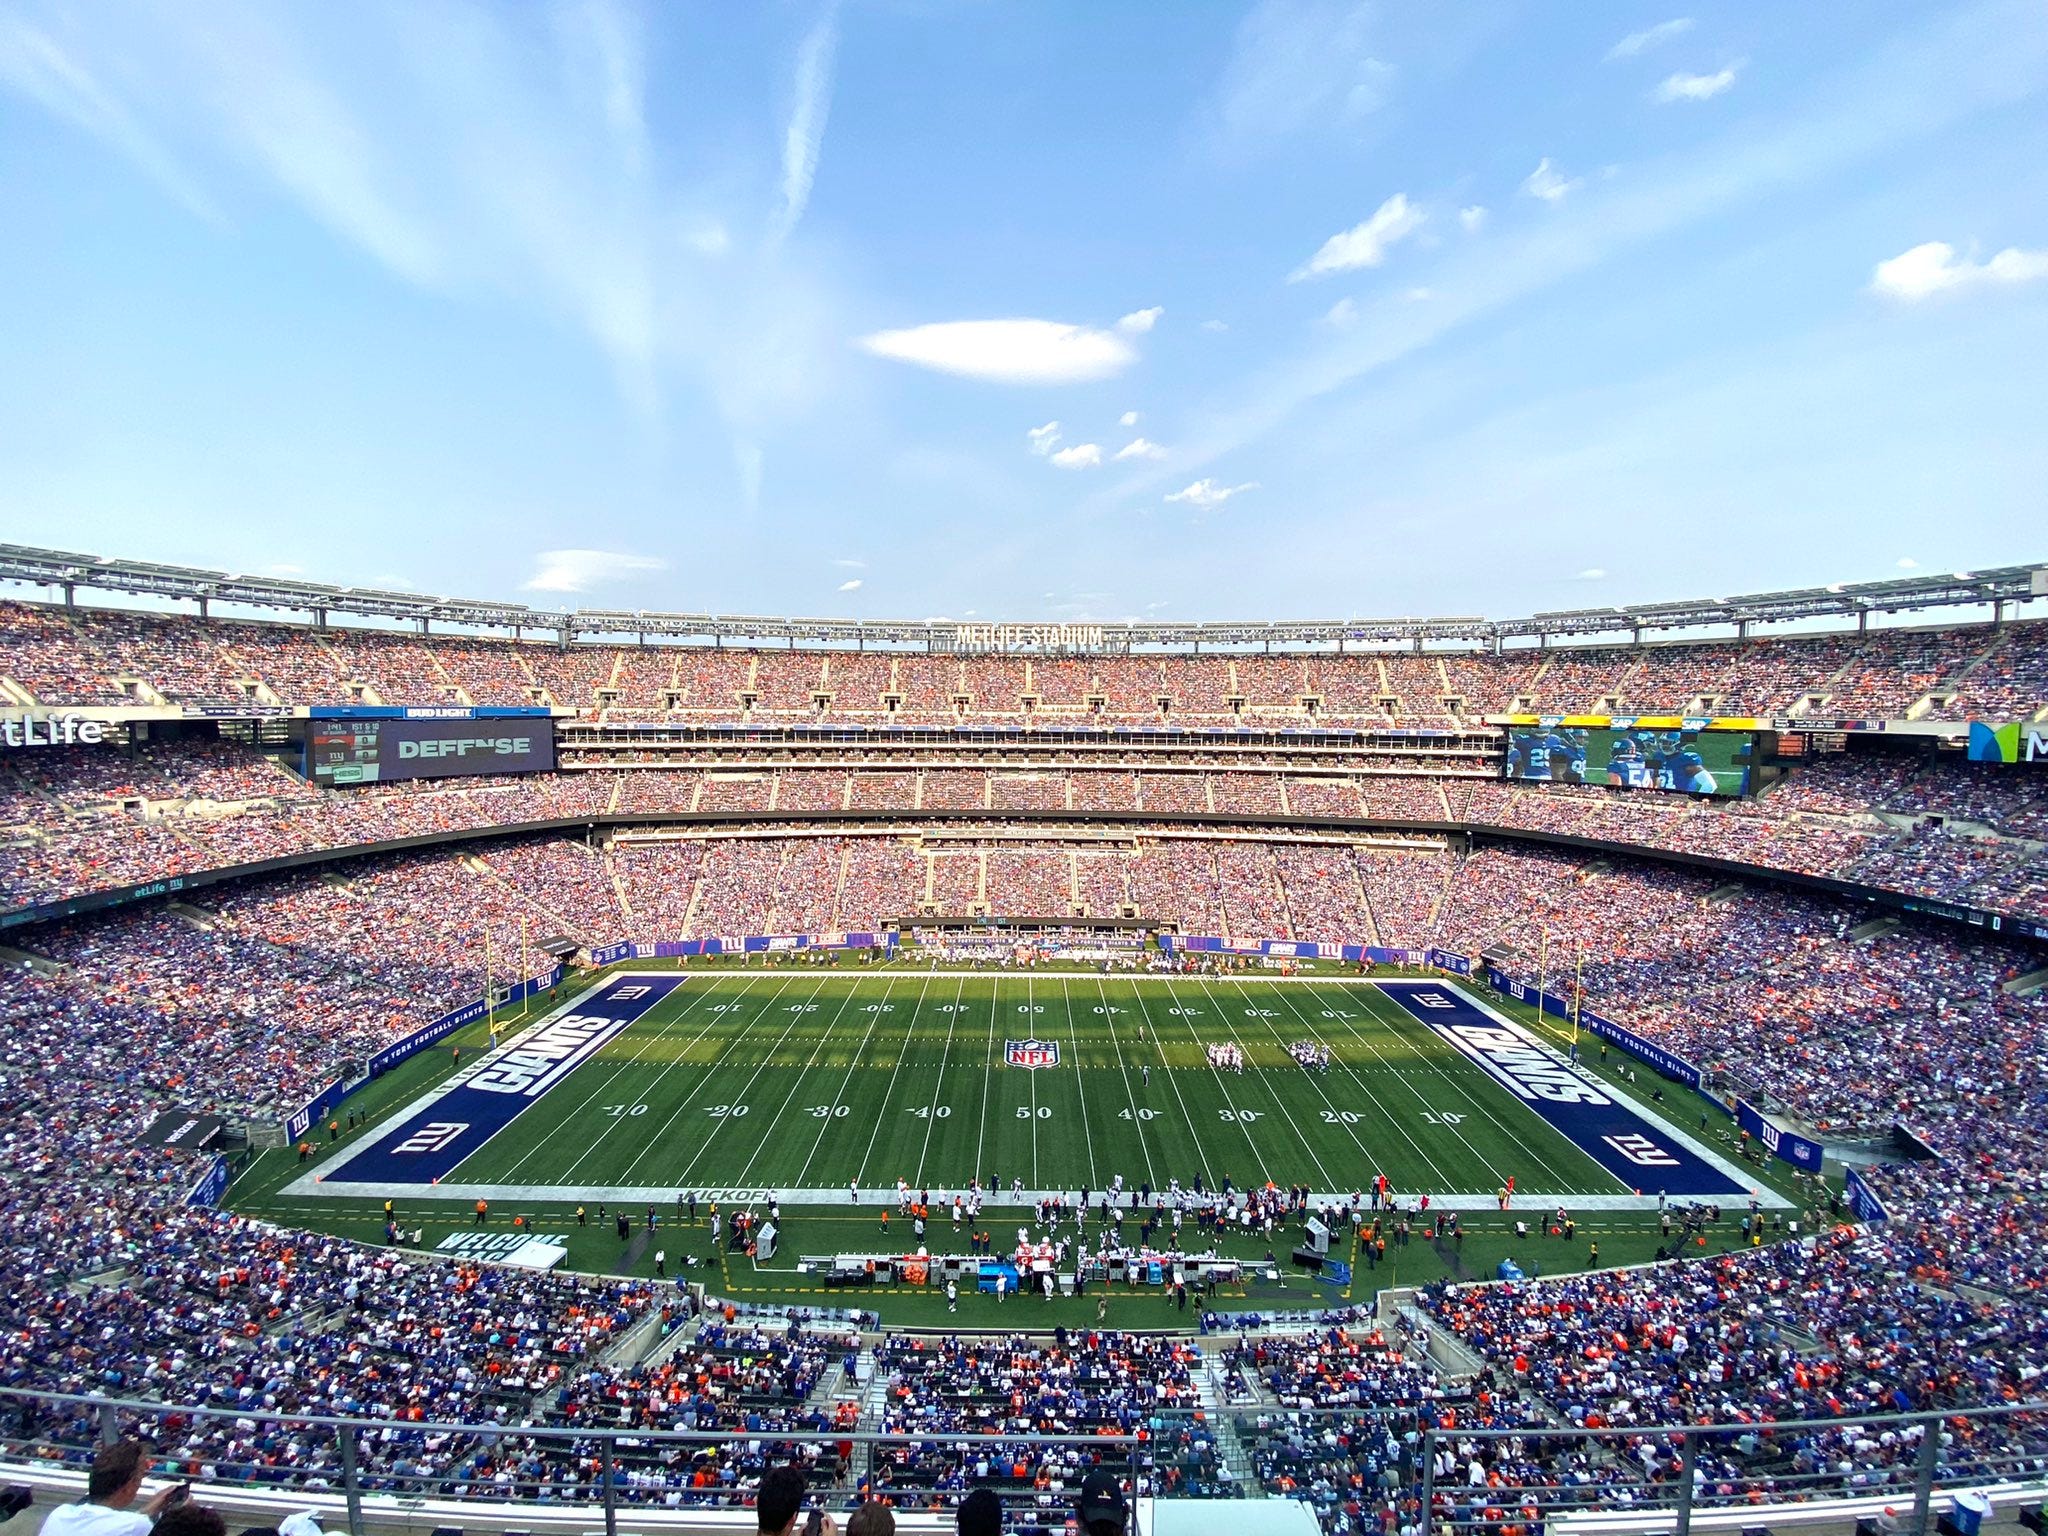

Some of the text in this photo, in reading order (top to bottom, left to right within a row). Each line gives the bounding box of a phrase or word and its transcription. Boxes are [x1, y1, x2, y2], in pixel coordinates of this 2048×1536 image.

[957, 625, 1103, 645] METLIFE STADIUM
[407, 708, 472, 718] BUD LIGHT
[1, 712, 103, 747] tLife
[1539, 717, 1560, 728] SAP
[1611, 718, 1633, 730] SAP
[1682, 719, 1705, 731] SAP
[720, 936, 745, 953] ny
[873, 933, 889, 946] ny
[1171, 937, 1187, 949] ny
[636, 944, 655, 958] ny
[1317, 942, 1343, 959] ny
[1407, 950, 1426, 964] ny
[536, 973, 551, 991] ny
[607, 985, 652, 1000] ny
[1509, 980, 1525, 1000] ny
[1410, 993, 1456, 1008] ny
[391, 1043, 412, 1059] YORK
[415, 1021, 452, 1046] FOOTBALL
[455, 1006, 484, 1024] GIANTS
[1602, 1024, 1622, 1041] YORK
[1625, 1036, 1664, 1064] FOOTBALL
[466, 1014, 611, 1094] GIANTS
[1011, 1051, 1054, 1065] NFL
[453, 1054, 500, 1081] TAKES
[1451, 1025, 1611, 1105] GIANTS
[609, 1104, 648, 1116] 10
[710, 1105, 750, 1118] 20
[812, 1105, 850, 1118] 30
[913, 1105, 951, 1119] 40
[1016, 1106, 1052, 1119] 50
[1118, 1107, 1154, 1121] 40
[1218, 1109, 1255, 1122] 30
[1320, 1110, 1360, 1124] 20
[292, 1108, 309, 1138] ny
[1420, 1112, 1462, 1125] 10
[164, 1119, 199, 1143] verizon
[391, 1122, 470, 1154] ny
[1761, 1121, 1779, 1152] ny
[1601, 1133, 1681, 1165] ny
[435, 1232, 570, 1250] WELCOME
